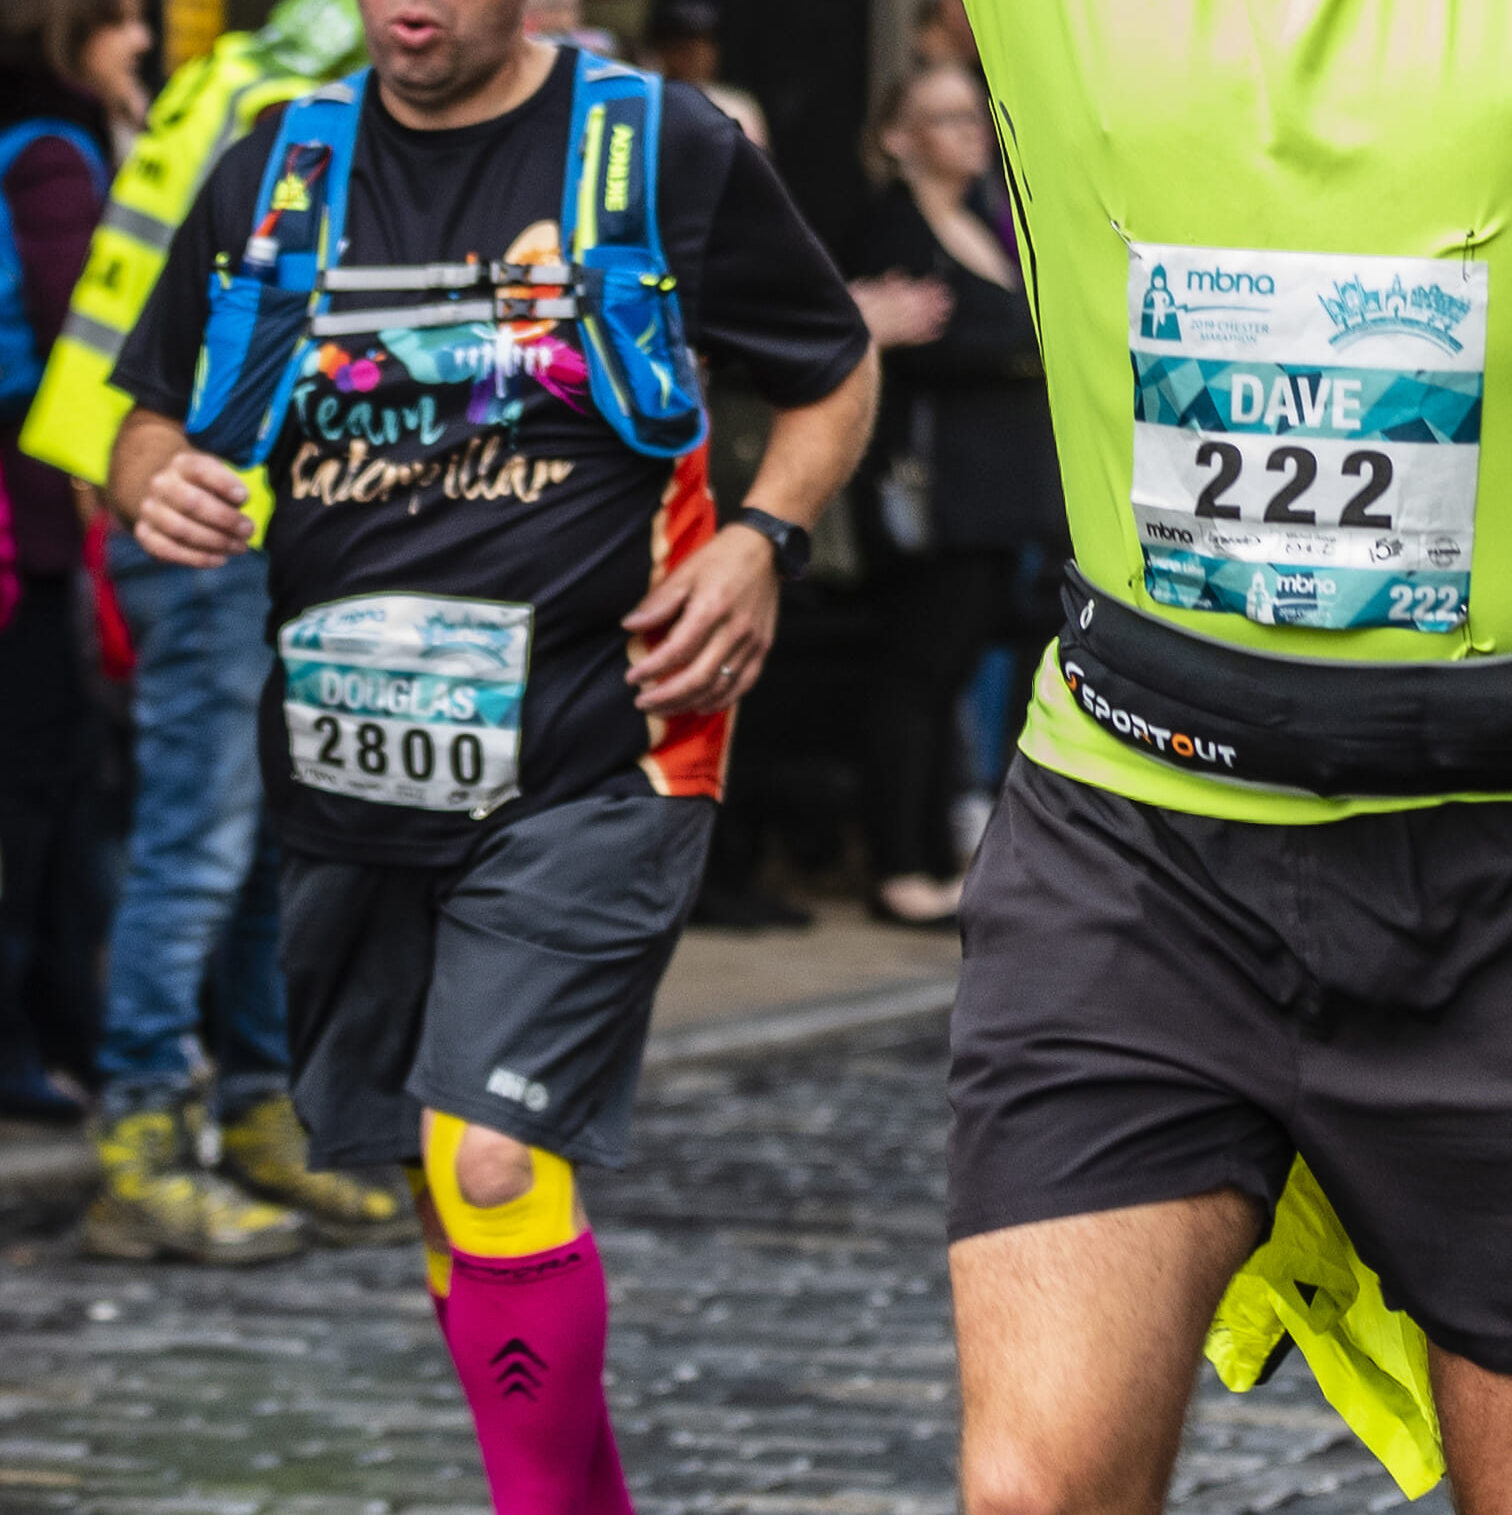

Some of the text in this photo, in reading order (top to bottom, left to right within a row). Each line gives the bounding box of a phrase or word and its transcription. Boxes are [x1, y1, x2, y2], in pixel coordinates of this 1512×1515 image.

[1187, 265, 1275, 295] mbna
[292, 382, 448, 446] Team
[1230, 373, 1362, 430] DAVE
[1194, 441, 1394, 530] 222
[1146, 521, 1194, 544] mbna
[1277, 573, 1336, 596] mbna
[1388, 584, 1459, 622] 222
[320, 667, 478, 721] DOUGLAS
[313, 715, 484, 787] 2800
[1081, 683, 1237, 769] SPORTOUT
